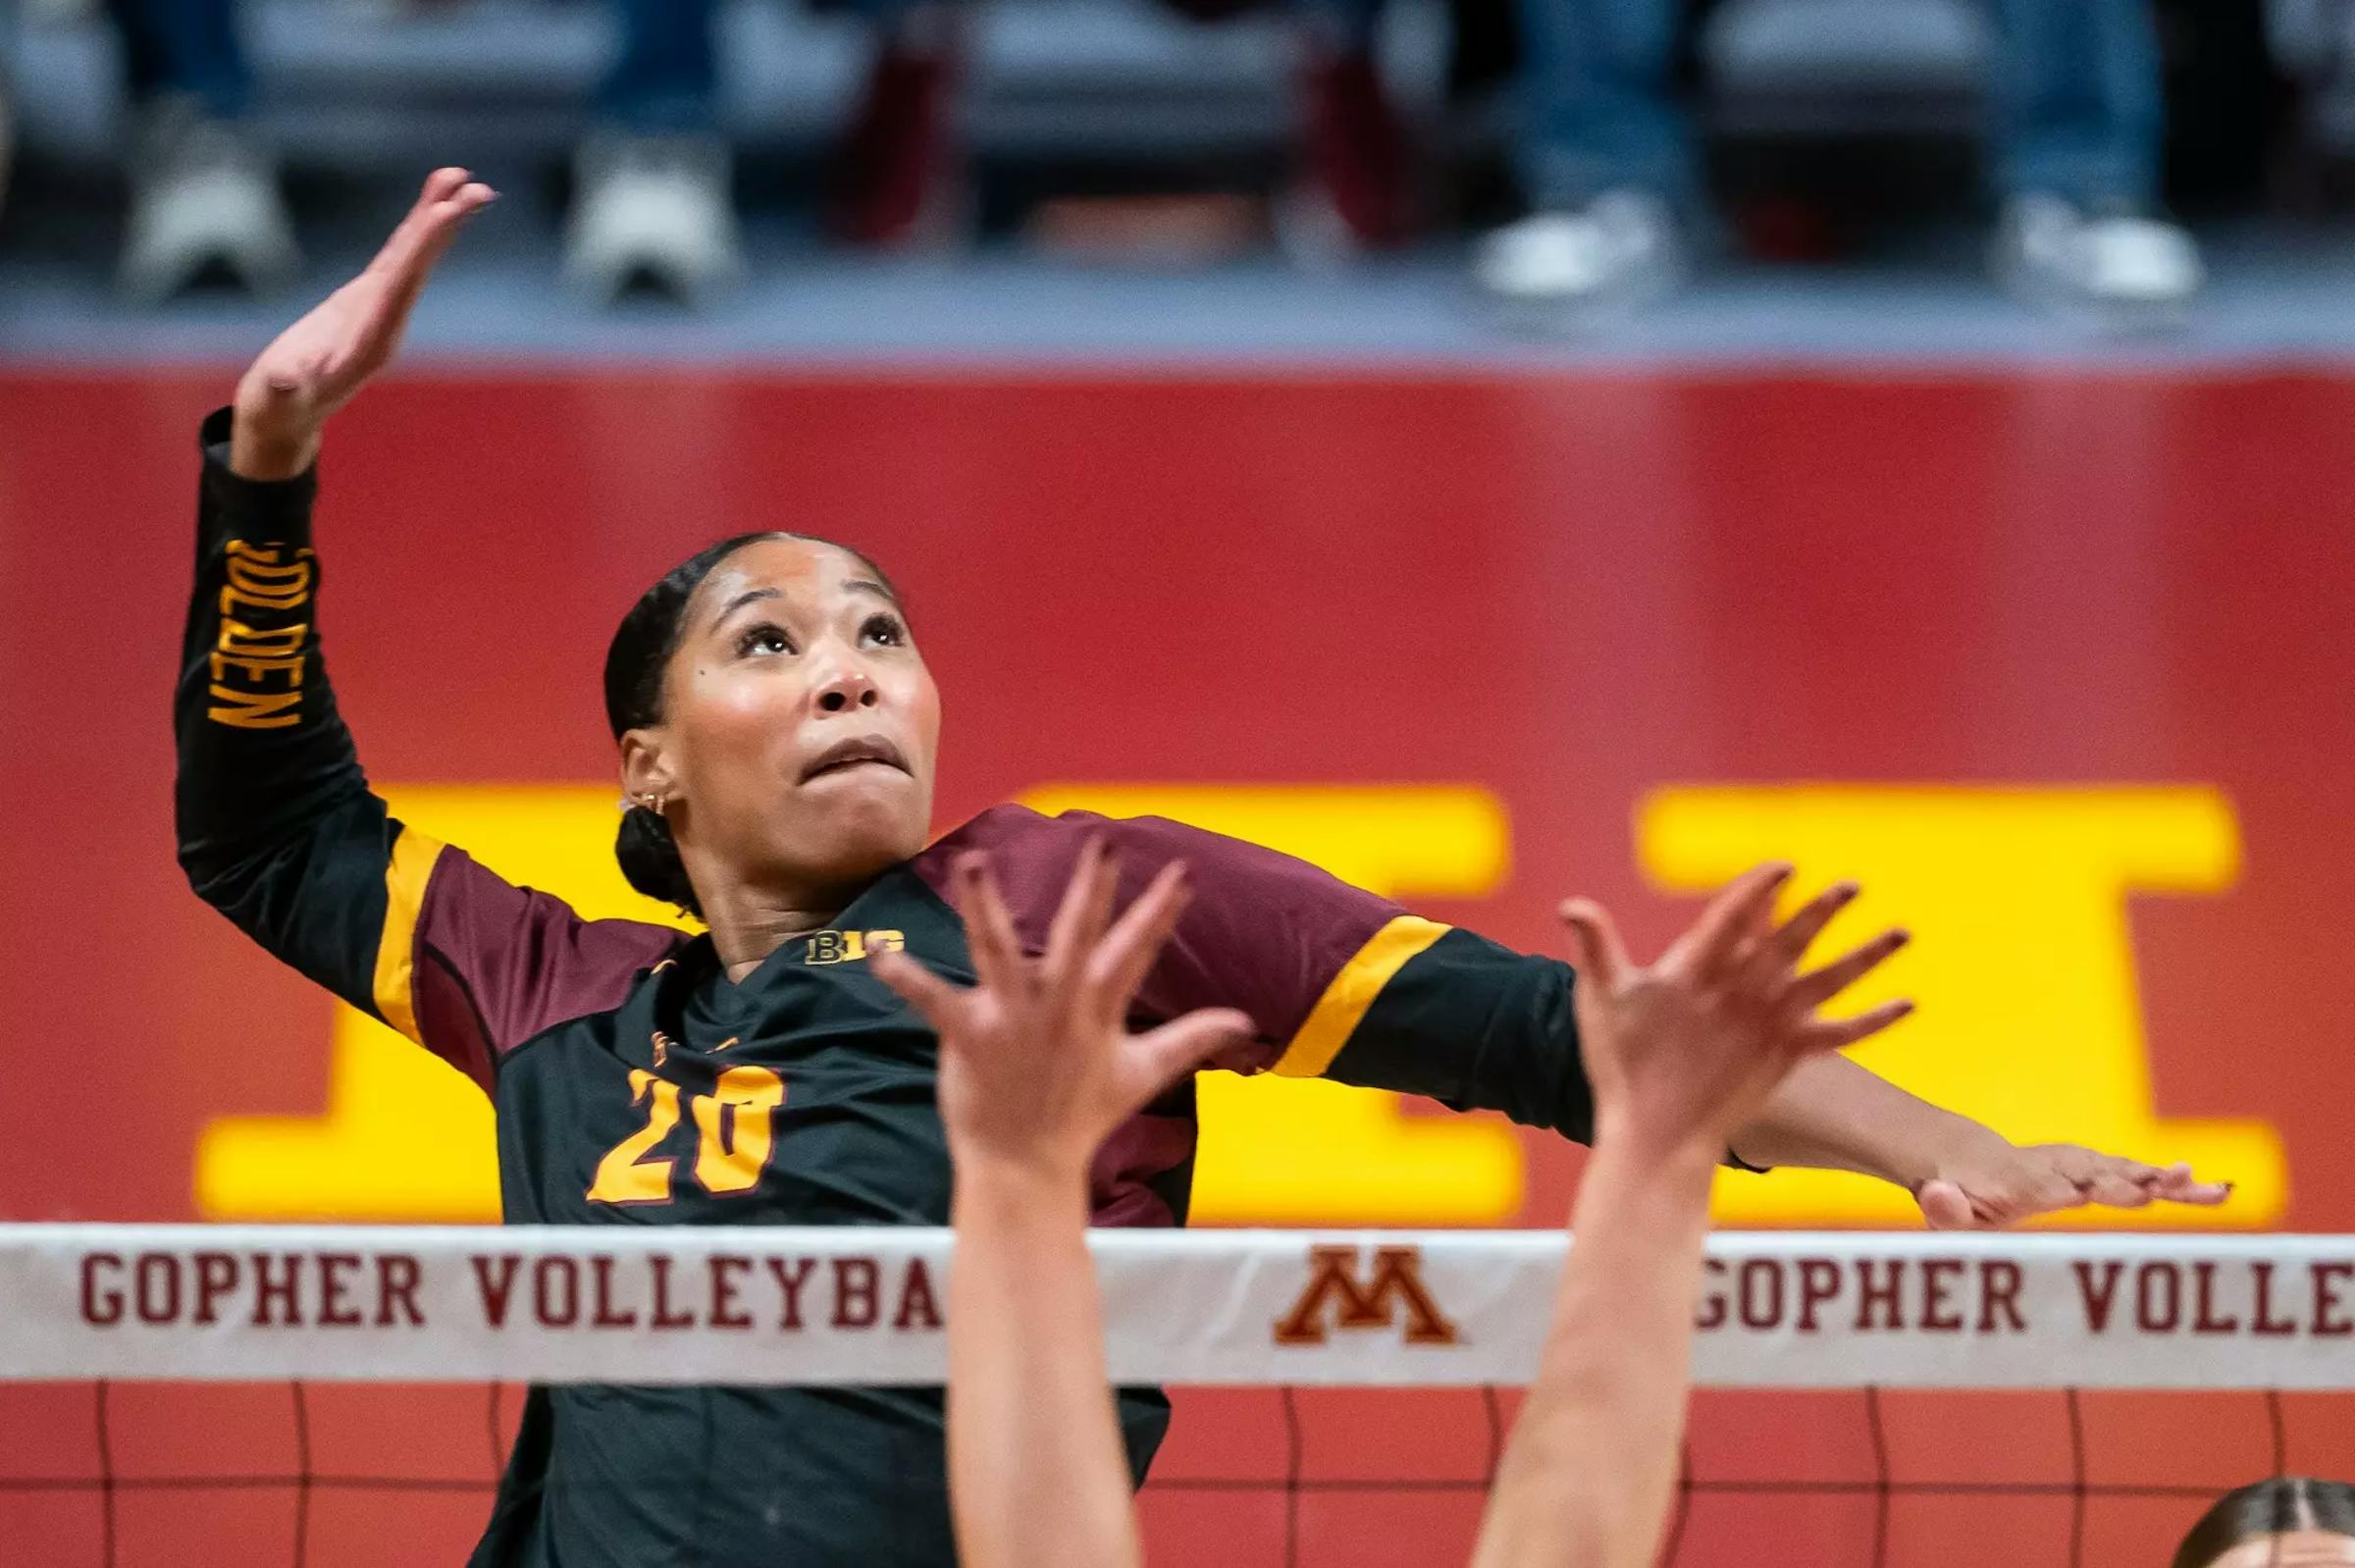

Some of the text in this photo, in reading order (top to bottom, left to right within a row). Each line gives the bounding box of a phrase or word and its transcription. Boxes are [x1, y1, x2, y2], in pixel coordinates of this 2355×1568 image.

[585, 1064, 787, 1206] 20
[78, 1251, 426, 1329] GOPHER
[1272, 1244, 1459, 1346] M
[2068, 1260, 2355, 1337] VOLLE
